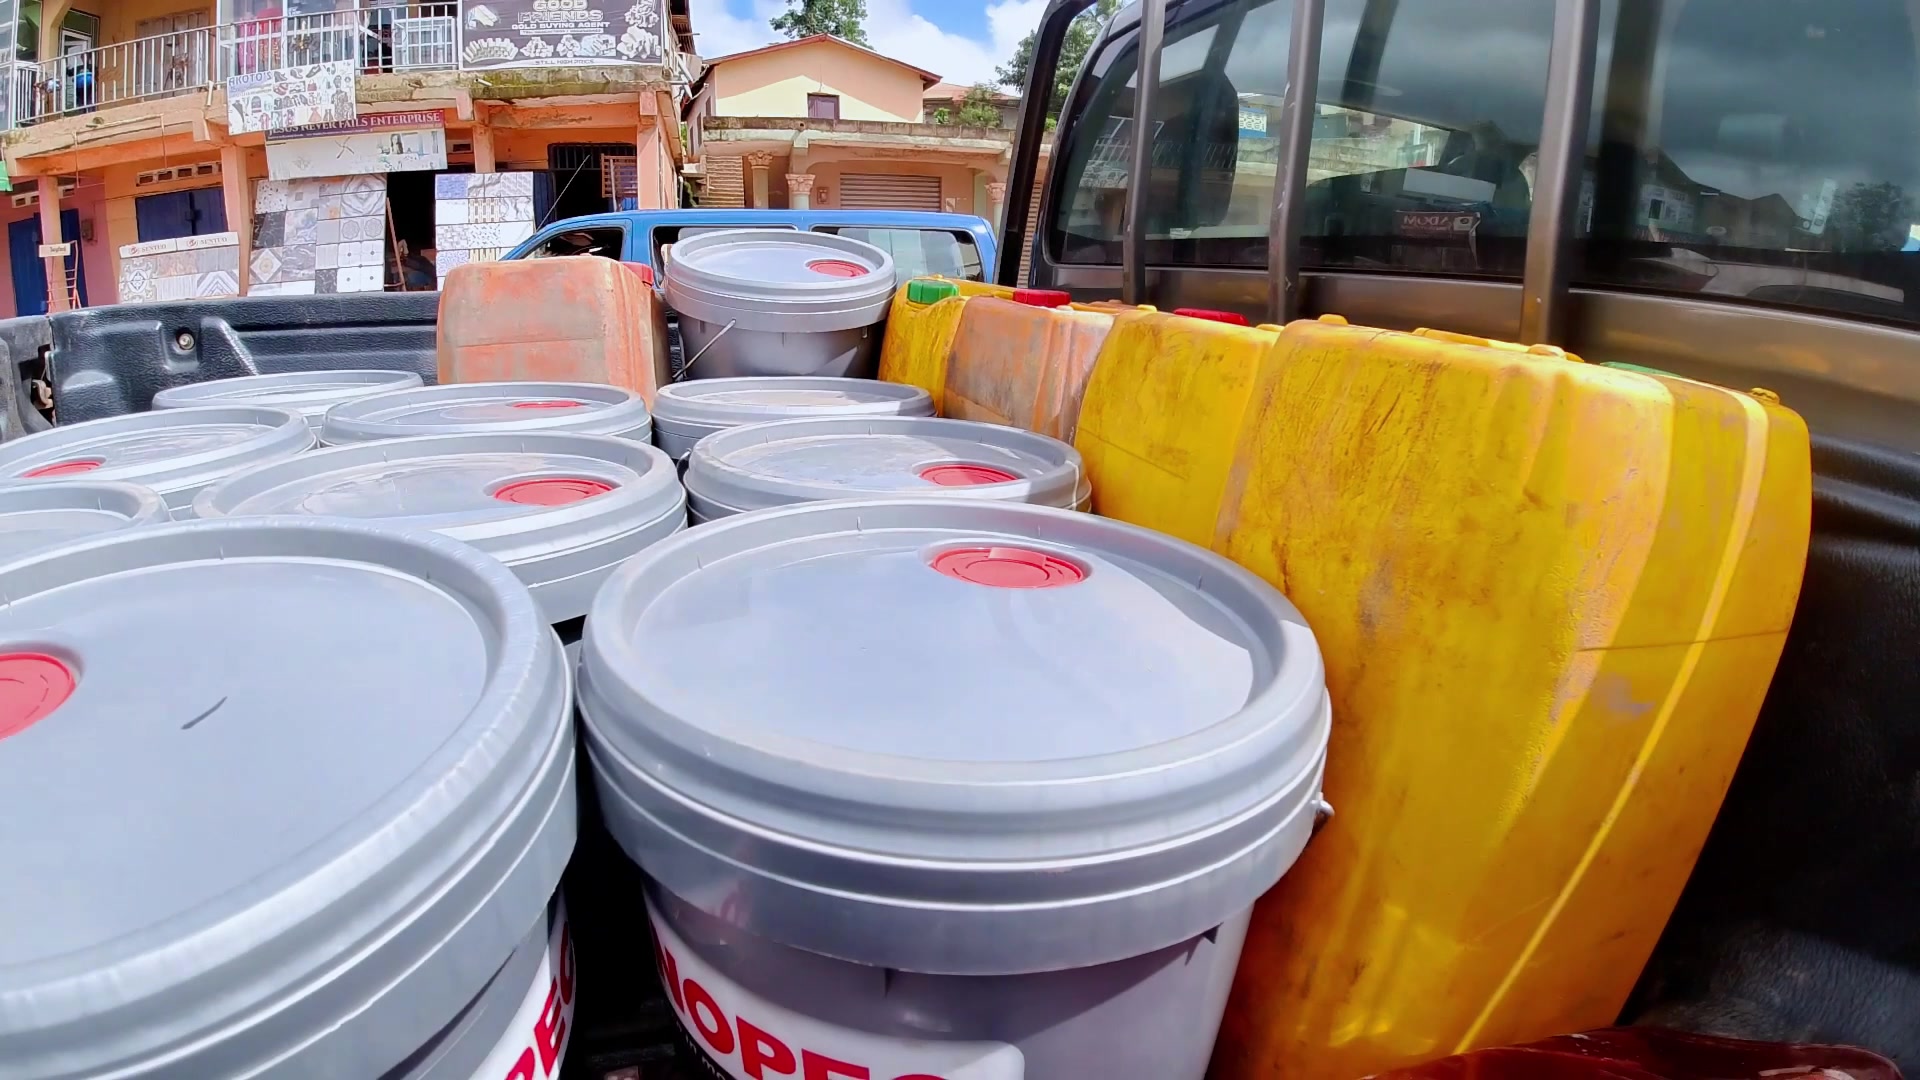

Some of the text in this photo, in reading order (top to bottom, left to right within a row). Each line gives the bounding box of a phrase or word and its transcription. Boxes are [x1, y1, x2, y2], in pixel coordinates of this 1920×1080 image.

[533, 0, 588, 11] GOOD
[517, 10, 604, 23] FRIENDS
[228, 71, 272, 86] AKOTO'S
[338, 117, 369, 129] FAILS
[370, 112, 442, 126] ENTERPRISE
